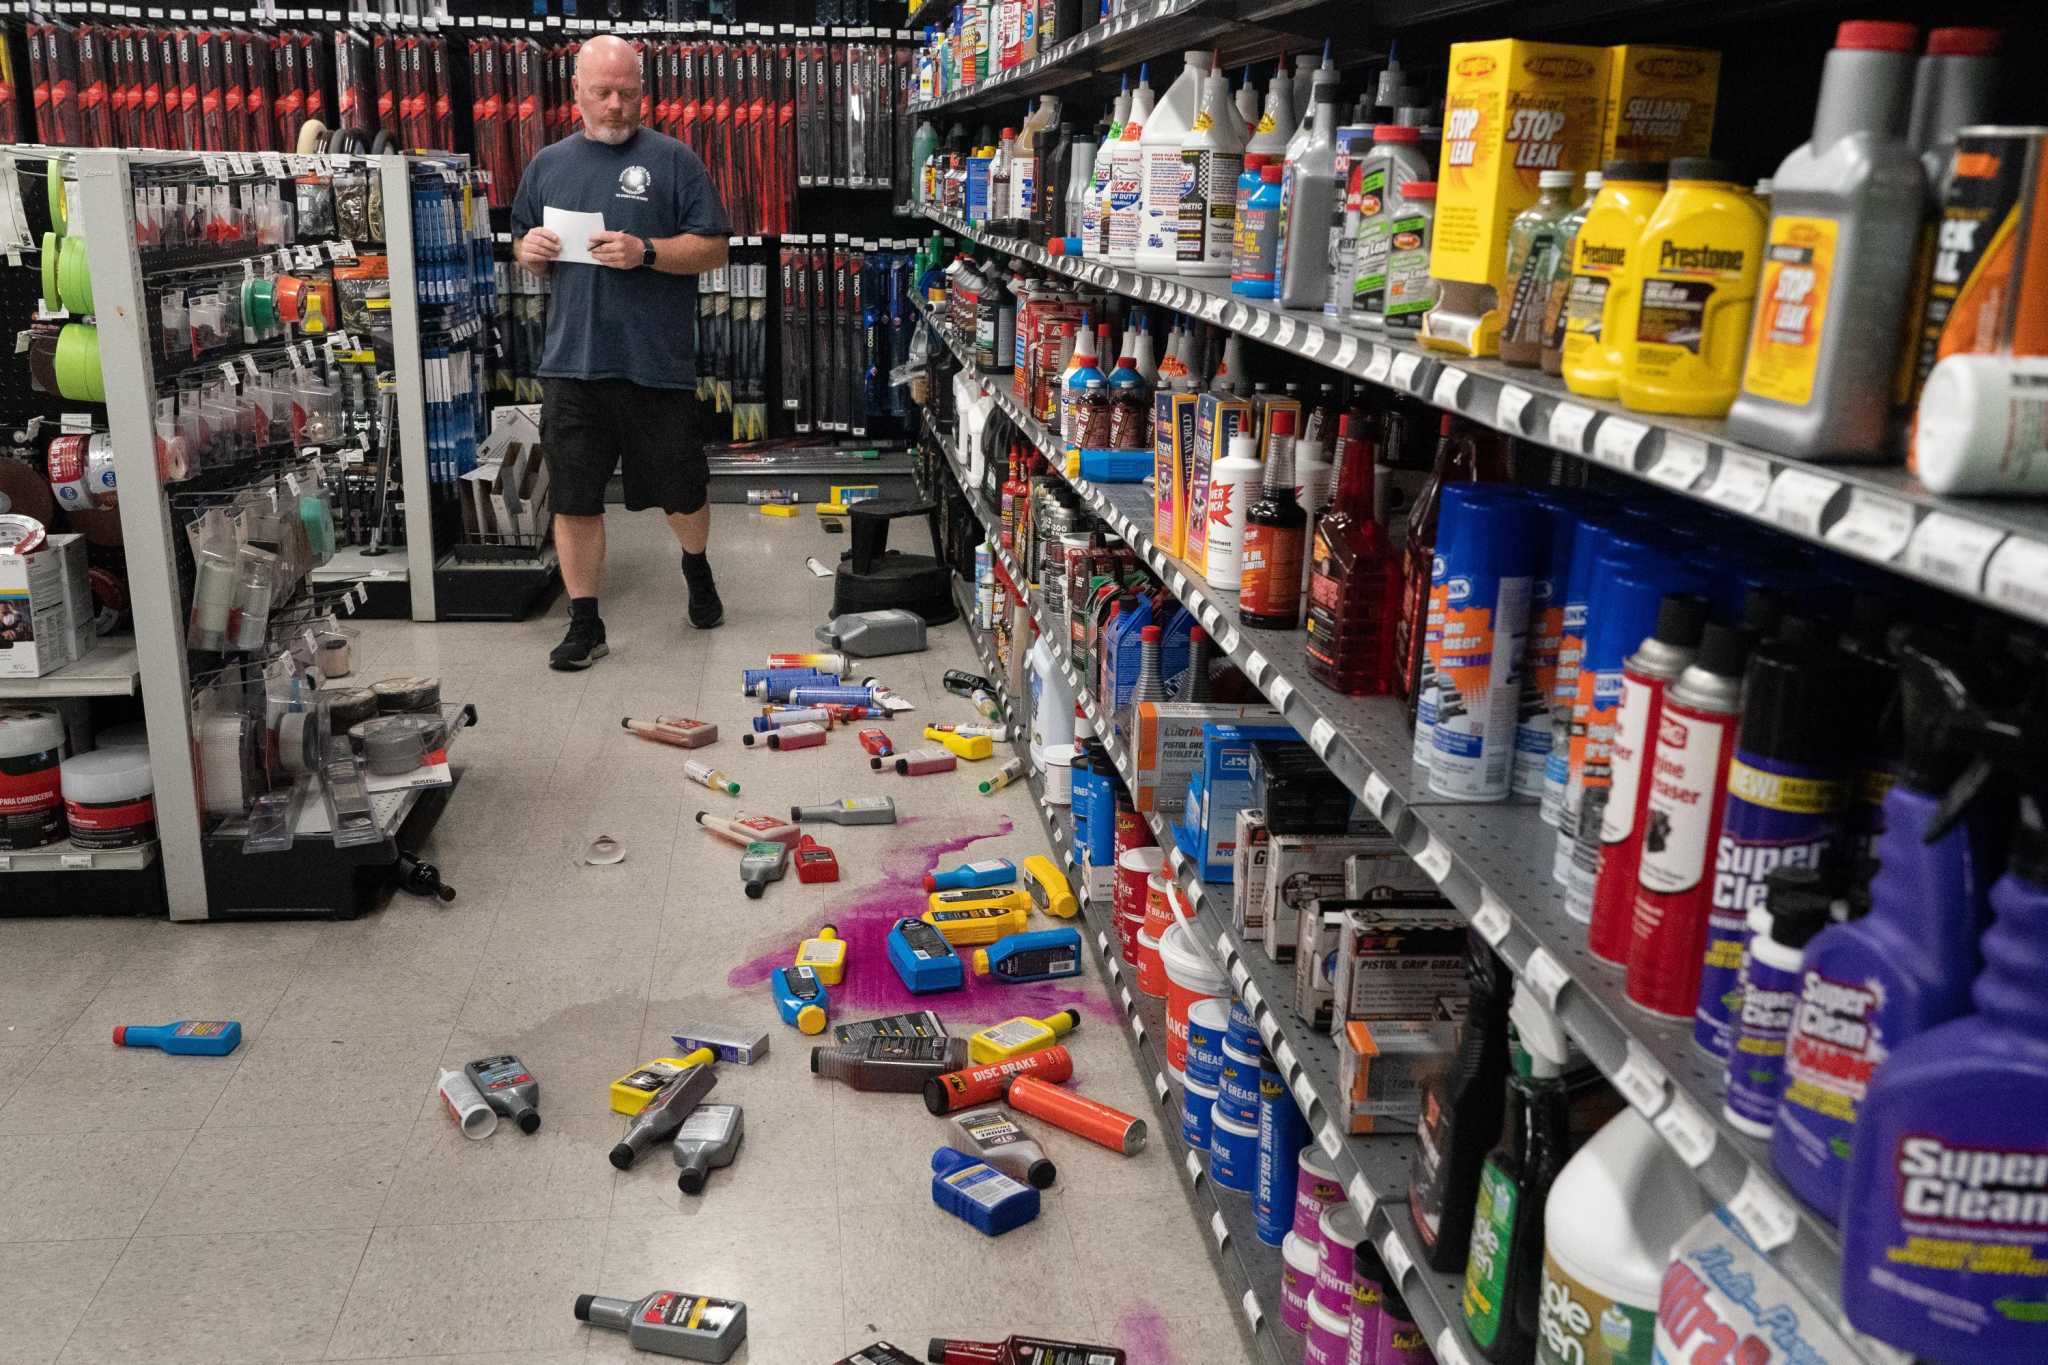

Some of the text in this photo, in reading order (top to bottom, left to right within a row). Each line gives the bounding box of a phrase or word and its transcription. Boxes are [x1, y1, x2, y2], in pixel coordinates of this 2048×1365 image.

[32, 36, 40, 59] TRICO
[50, 35, 58, 58] TRICO
[202, 44, 210, 67] TRICO
[1626, 99, 1691, 122] SELLADOR
[1447, 108, 1479, 140] STOP
[1507, 108, 1564, 142] STOP
[1449, 141, 1476, 165] LEAK
[1516, 143, 1563, 168] LEAK
[1111, 181, 1137, 192] UCAS
[1581, 240, 1626, 266] Prestone
[1659, 241, 1743, 270] Prestone
[1776, 266, 1816, 300] STOP
[1775, 304, 1811, 330] LEAK
[1075, 407, 1090, 448] TUNE UP
[1110, 407, 1123, 448] TUNE UP
[1183, 414, 1192, 452] WORLD
[1224, 757, 1248, 766] KF
[16, 790, 54, 804] CARROCERIA
[1717, 836, 1830, 883] Super
[1712, 873, 1769, 911] Cle
[1361, 959, 1464, 970] PISTOL GRIP GREA
[1166, 1012, 1188, 1041] AKE
[1232, 1008, 1254, 1026] GREAS
[1801, 1006, 1868, 1051] Clean
[972, 1056, 1039, 1082] DISC BRAKE
[1198, 1052, 1223, 1066] GREAS
[1227, 1084, 1258, 1102] GREASE
[981, 1128, 1012, 1138] SMOKE
[1258, 1101, 1272, 1202] MARINE GREASE
[1901, 1138, 2048, 1187] Super
[1904, 1178, 2048, 1224] Clean
[1320, 1272, 1352, 1294] WHITE
[1288, 1290, 1308, 1310] WHIT
